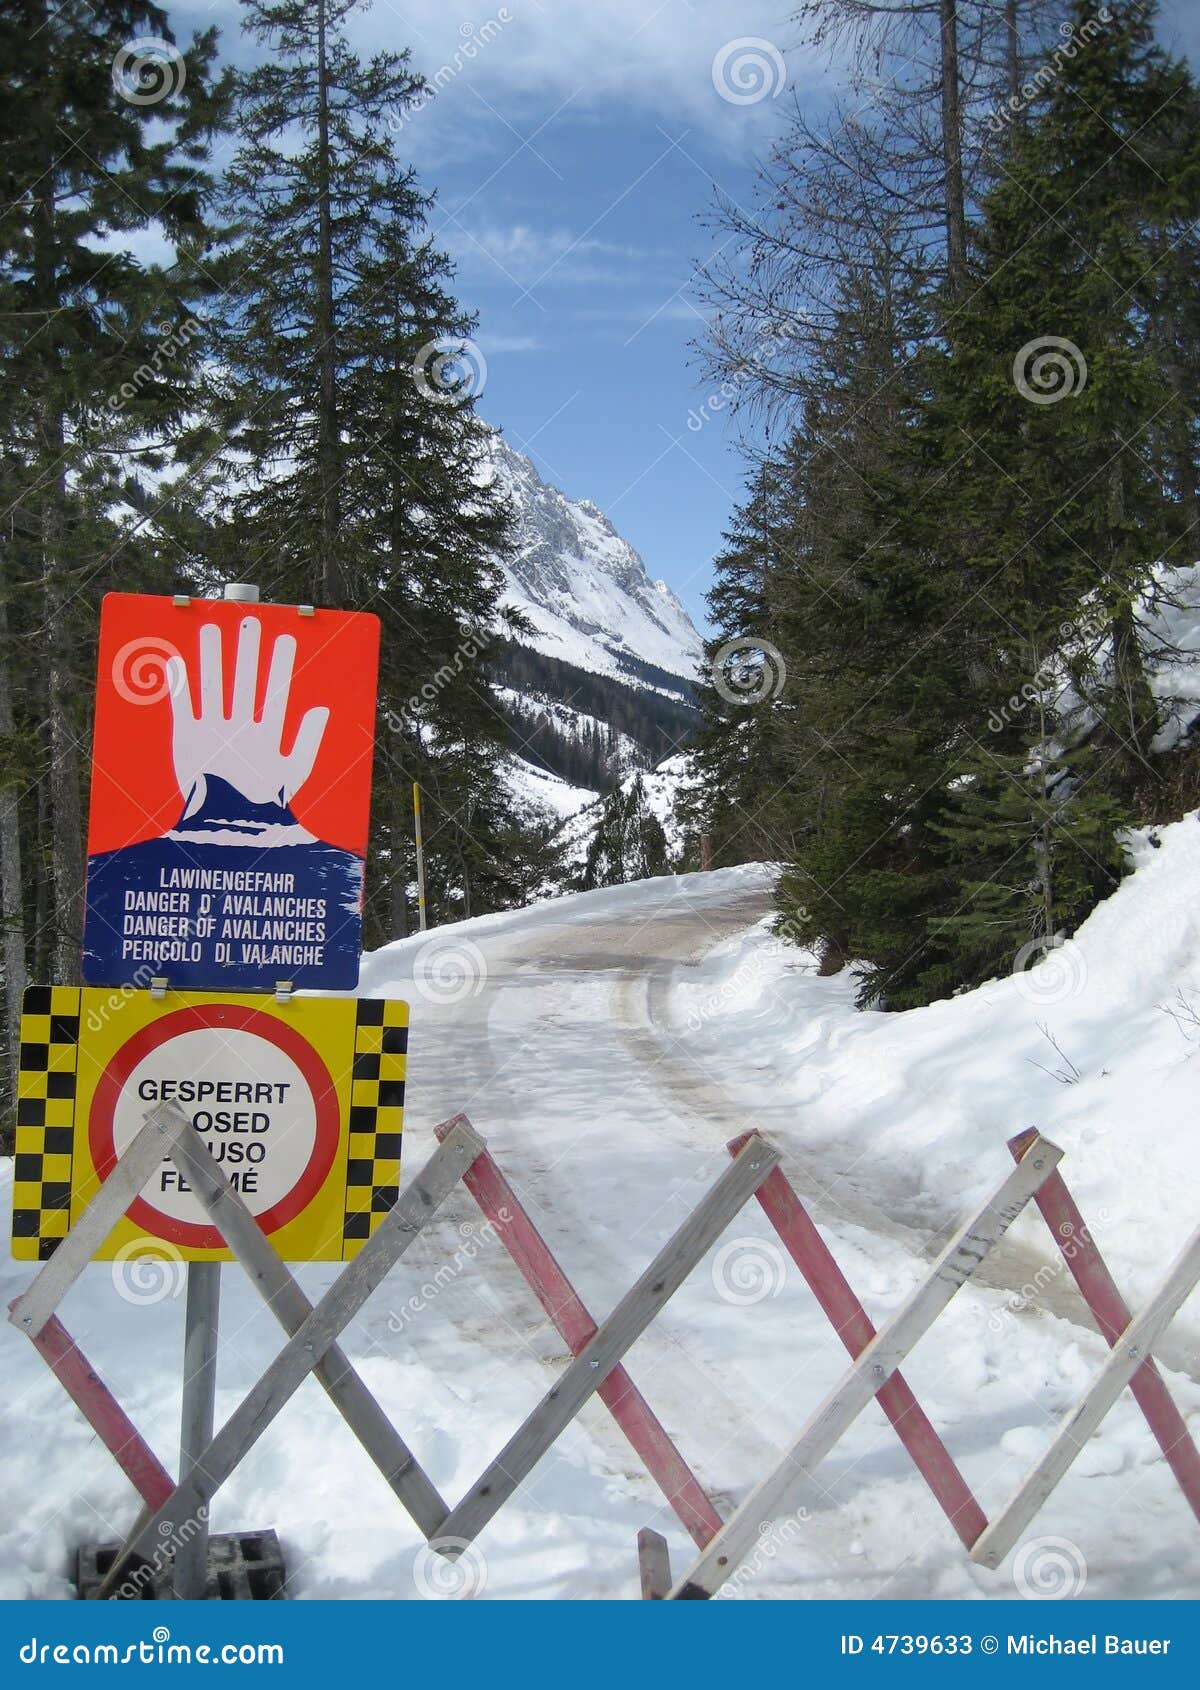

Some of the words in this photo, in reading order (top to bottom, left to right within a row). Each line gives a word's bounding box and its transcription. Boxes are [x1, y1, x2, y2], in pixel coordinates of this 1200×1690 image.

[159, 868, 295, 893] LAWINENGEFAHR
[124, 890, 190, 913] DANGER
[222, 895, 326, 919] AVALANCHES
[123, 915, 189, 937] DANGER
[196, 918, 217, 938] OF
[221, 919, 326, 942] AVALANCHES
[122, 940, 201, 962] PERICOLO
[215, 942, 231, 964] DI
[242, 943, 324, 966] VALANGHE
[138, 1079, 291, 1104] GESPERRT
[192, 1111, 270, 1133] OSED
[160, 1167, 259, 1193] FEMÉ
